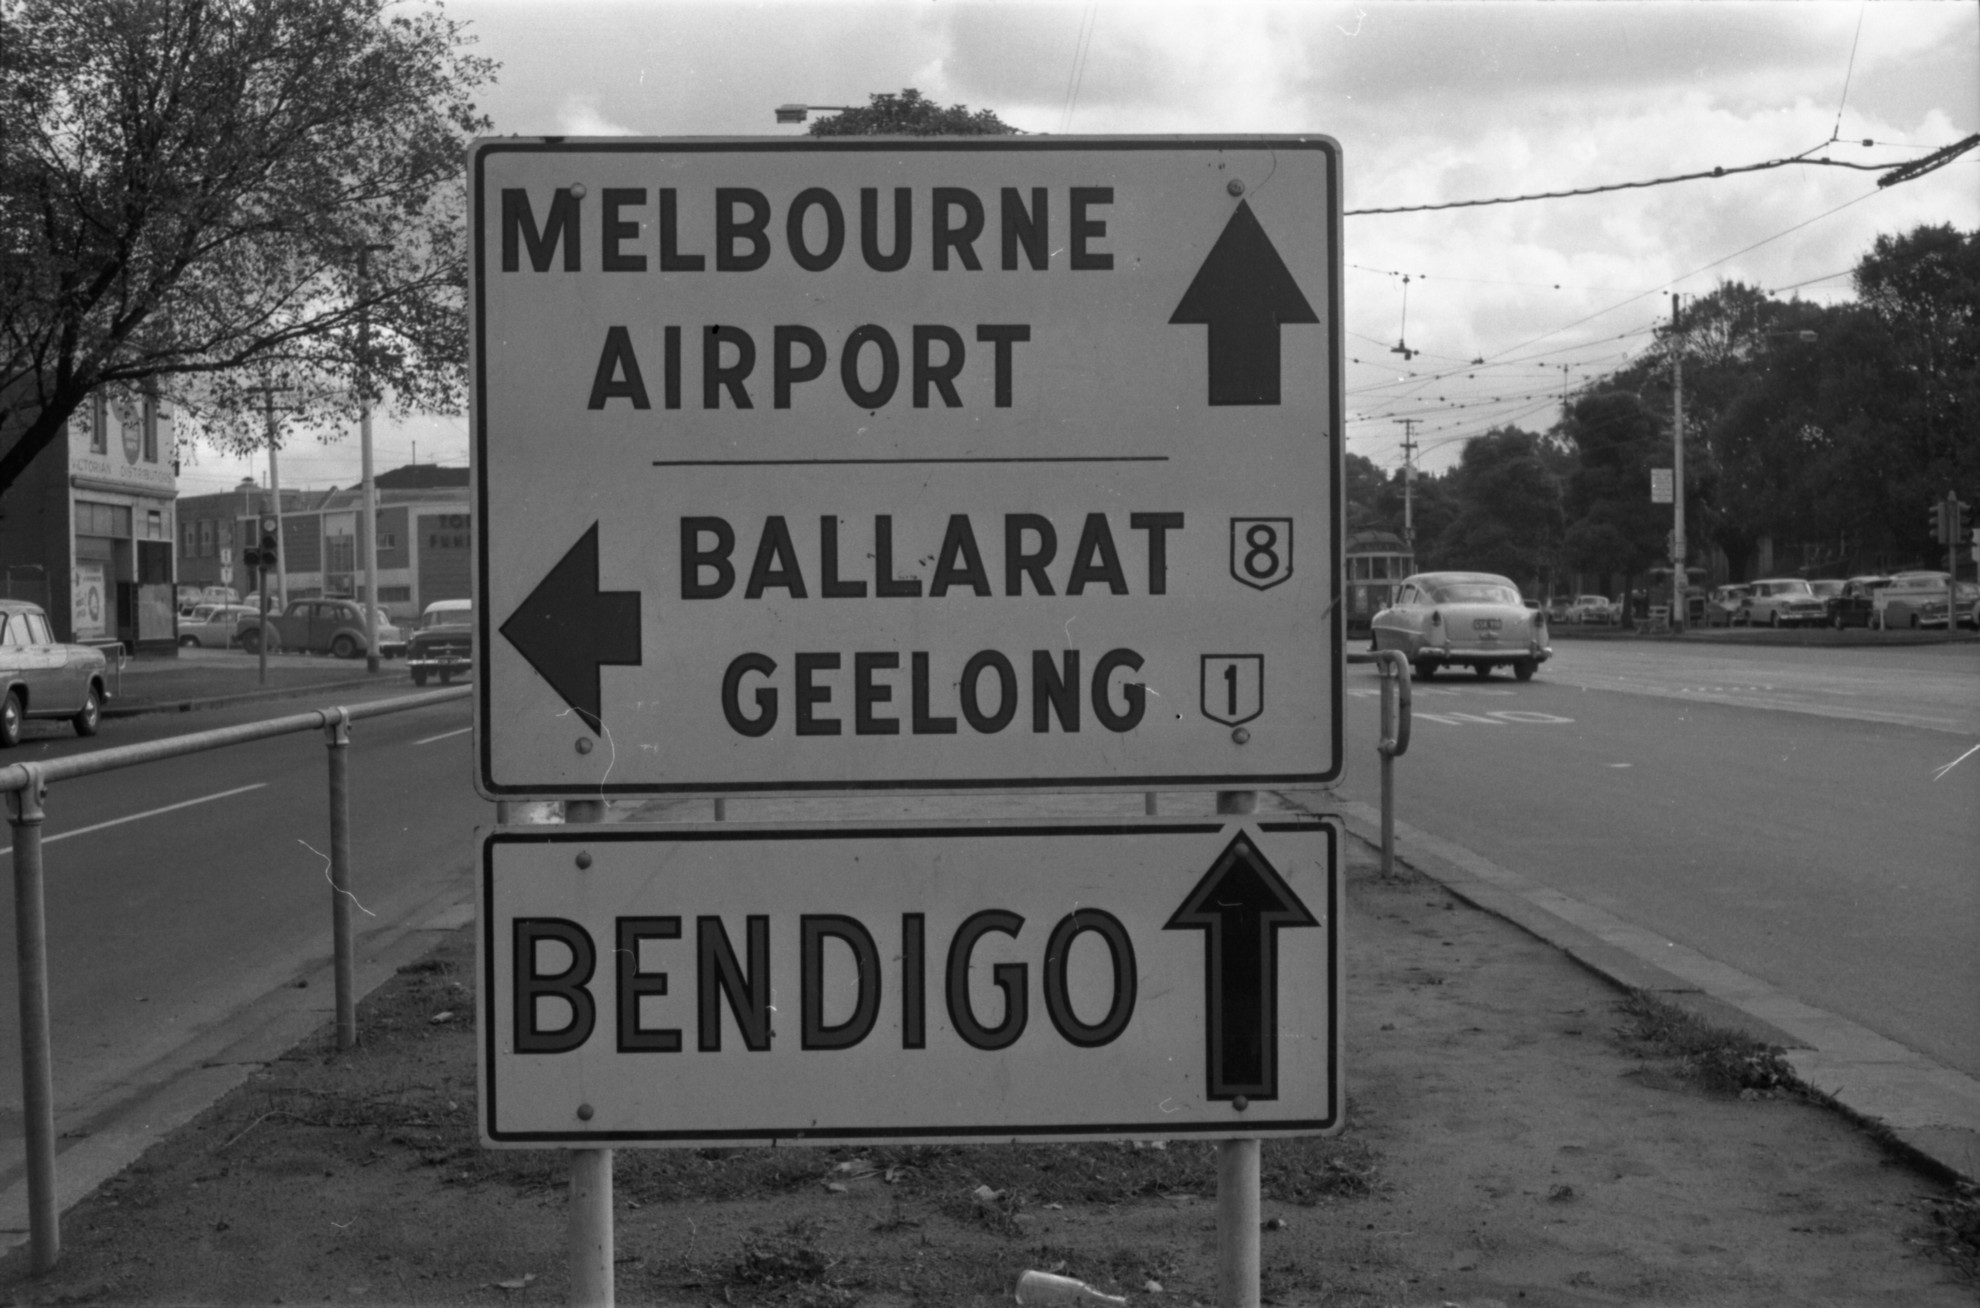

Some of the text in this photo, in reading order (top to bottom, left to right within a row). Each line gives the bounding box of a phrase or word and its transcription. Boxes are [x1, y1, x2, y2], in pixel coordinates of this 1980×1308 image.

[500, 186, 1114, 273] MELBOURNE
[586, 323, 1031, 411] AIRPORT
[679, 511, 1280, 601] BALLARAT 8
[720, 647, 1238, 738] GEELONG 1
[511, 907, 1138, 1056] BENDIGO
